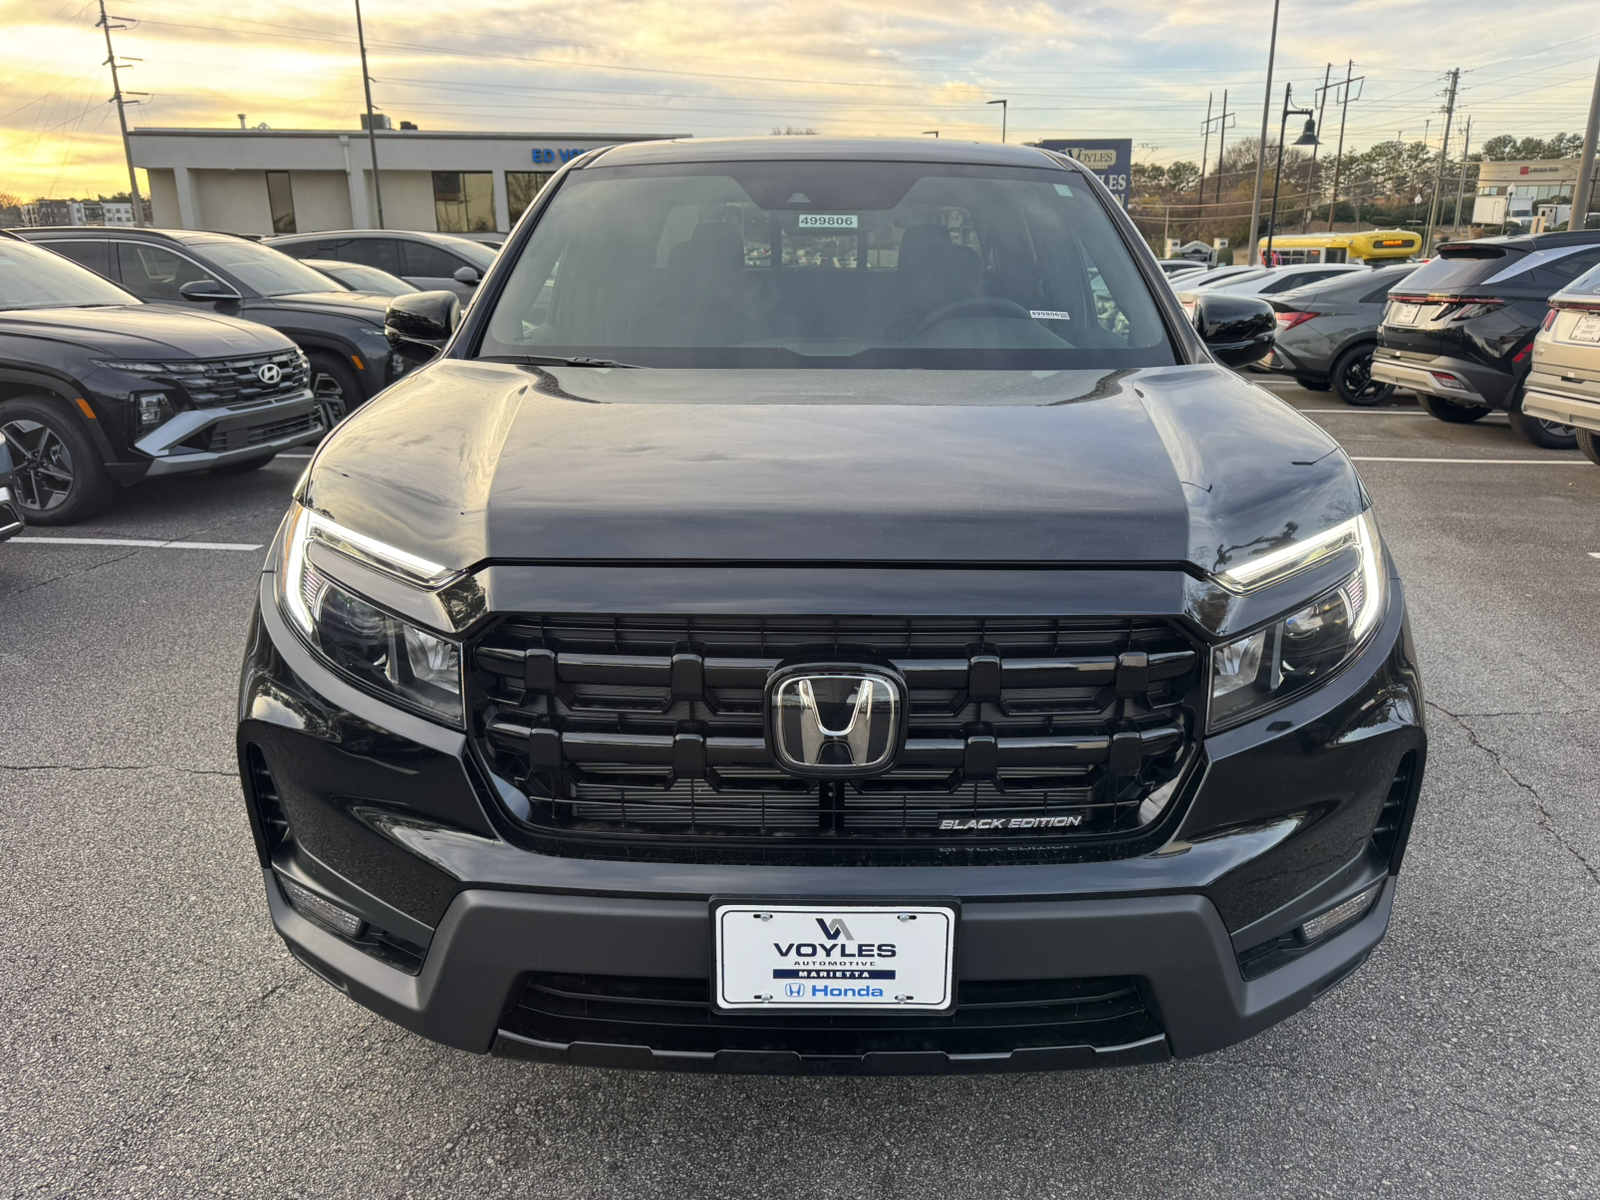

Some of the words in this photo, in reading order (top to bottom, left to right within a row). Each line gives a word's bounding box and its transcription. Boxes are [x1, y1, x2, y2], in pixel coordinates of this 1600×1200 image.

[531, 148, 554, 162] ED
[558, 149, 586, 163] VO
[1067, 149, 1112, 162] VOYLES
[801, 216, 853, 225] 499806
[939, 818, 1006, 830] BLACK
[1008, 815, 1082, 828] EDITION
[773, 943, 897, 958] VOYLES
[811, 985, 884, 997] Honda
